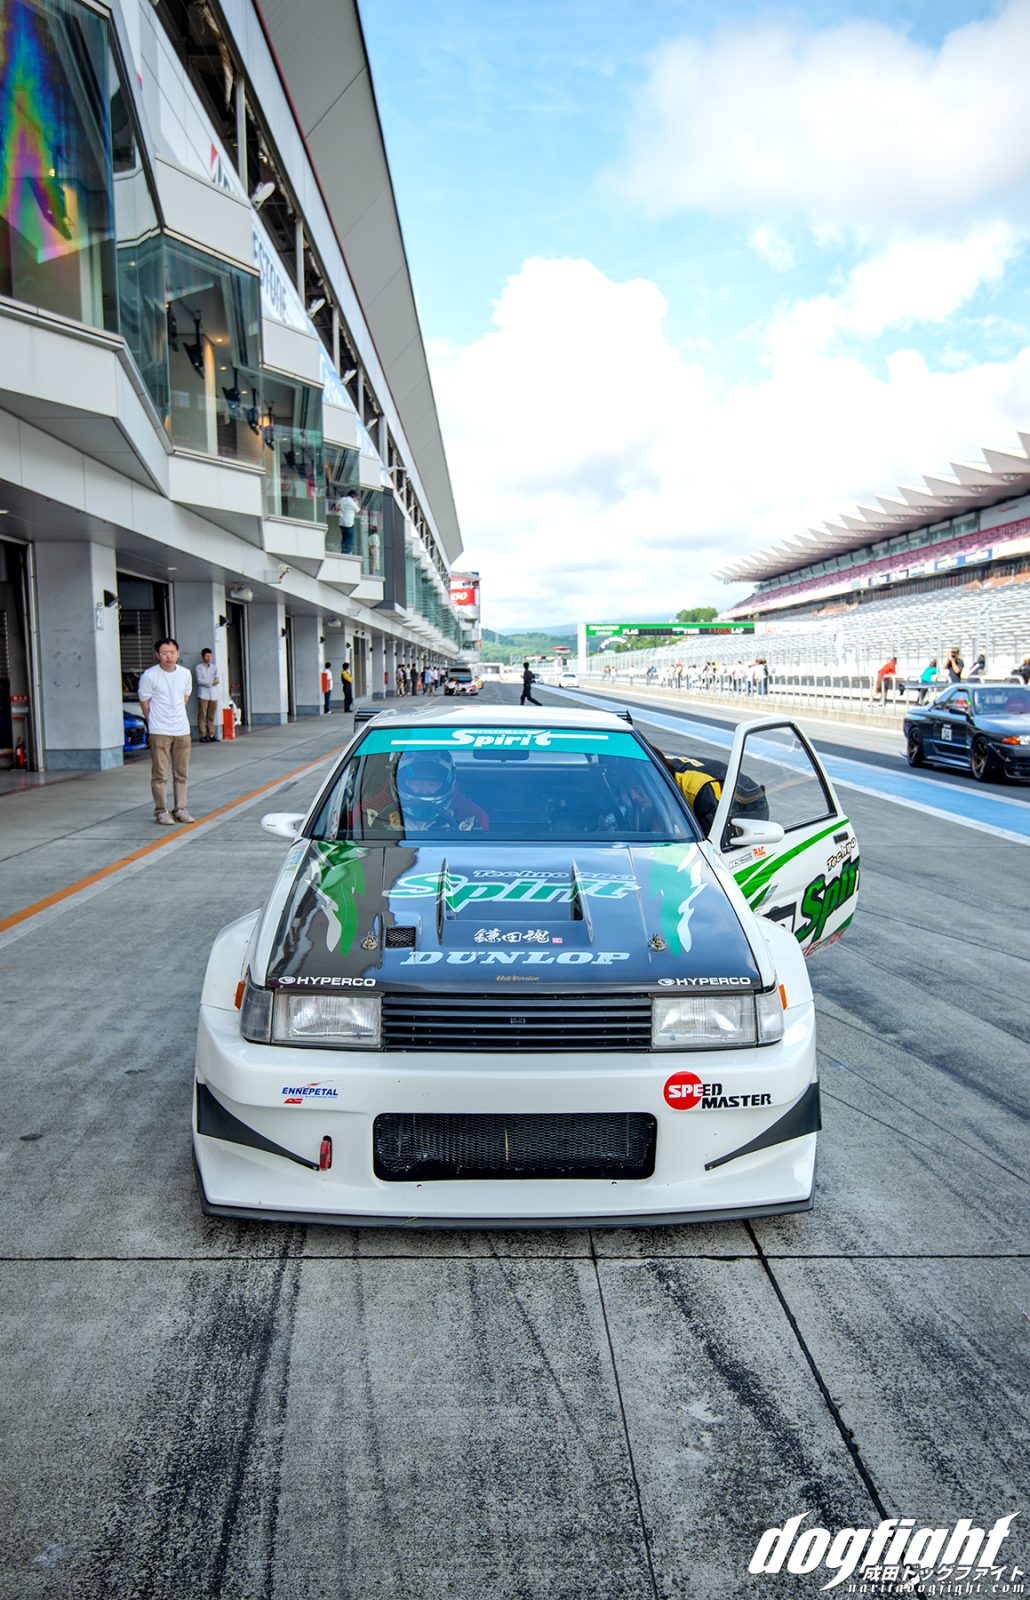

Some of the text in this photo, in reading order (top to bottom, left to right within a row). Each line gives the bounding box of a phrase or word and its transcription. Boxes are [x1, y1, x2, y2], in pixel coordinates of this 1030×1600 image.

[451, 729, 552, 748] Spirit
[400, 951, 631, 965] DUNLOP
[296, 976, 376, 987] HYPERCO
[676, 977, 752, 986] HYPERCO
[282, 1086, 339, 1096] ENNEPETAL
[668, 1083, 723, 1098] SPEED
[701, 1093, 773, 1109] MASTER
